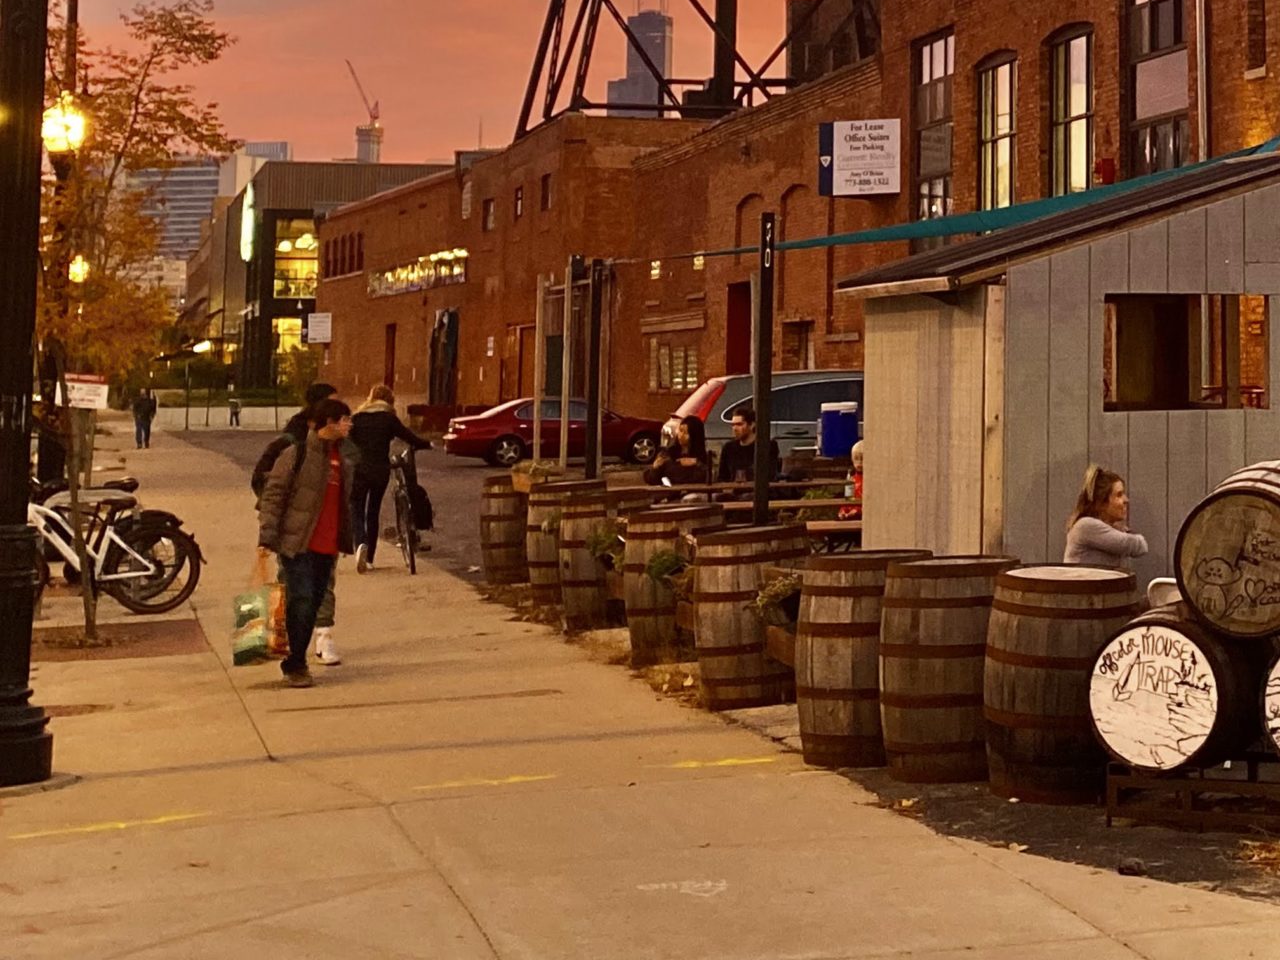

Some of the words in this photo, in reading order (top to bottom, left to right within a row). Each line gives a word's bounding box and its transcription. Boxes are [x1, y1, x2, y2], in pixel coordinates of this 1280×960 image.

[851, 123, 862, 131] For
[865, 123, 884, 131] Lease
[844, 134, 866, 142] Office
[868, 133, 889, 141] Suites
